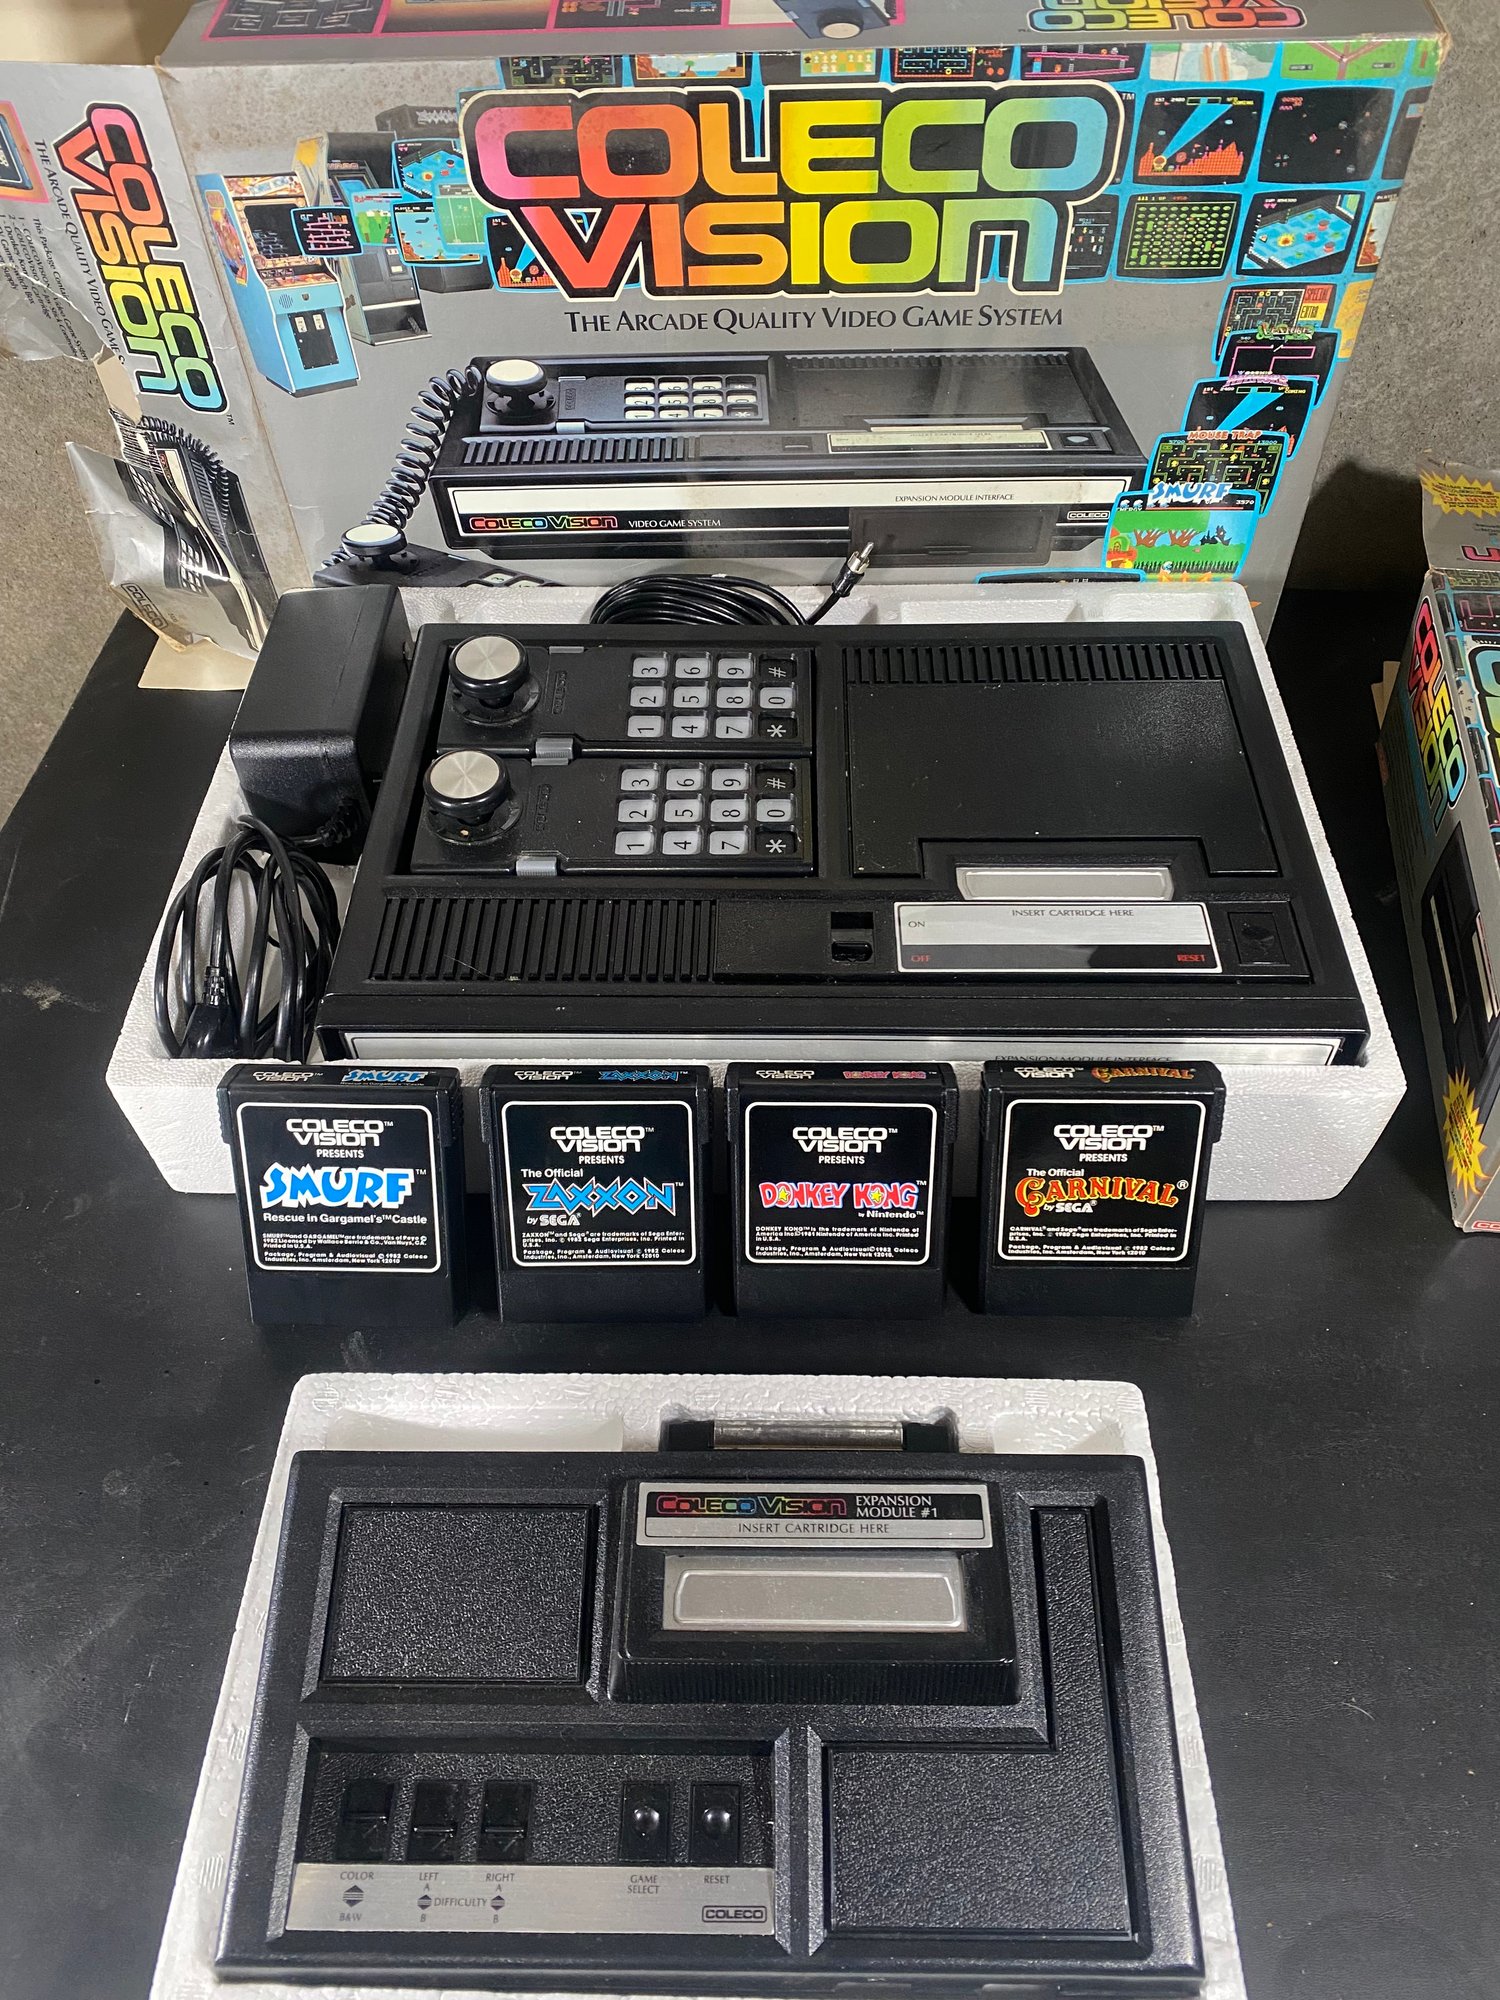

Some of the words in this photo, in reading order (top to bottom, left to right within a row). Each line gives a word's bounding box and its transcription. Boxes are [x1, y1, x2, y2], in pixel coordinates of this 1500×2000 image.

[1032, 7, 1301, 30] COLECO
[472, 95, 1110, 201] COLECO
[34, 138, 51, 167] THE
[47, 168, 71, 221] ARCADE
[64, 221, 91, 282] QUALITY
[86, 280, 106, 317] VIDEO
[518, 198, 1060, 290] VISION
[57, 126, 178, 392] VISION
[89, 106, 224, 410] COLECO
[564, 311, 611, 333] THE
[616, 311, 709, 332] ARCADE
[713, 308, 816, 335] QUALITY
[821, 307, 896, 329] VIDEO
[903, 305, 973, 328] GAME
[977, 305, 1063, 327] SYSTEM
[1187, 431, 1228, 440] MOUSE
[1231, 430, 1261, 439] TRAP
[1149, 481, 1233, 504] SMURF
[895, 494, 938, 502] EXPANSION
[628, 520, 657, 528] VIDEO
[659, 519, 686, 528] GAME
[687, 519, 721, 527] SYSTEM
[641, 667, 658, 675] 3
[639, 695, 656, 705] 2
[682, 695, 700, 704] 5
[726, 696, 744, 704] 8
[681, 724, 698, 734] 4
[726, 726, 743, 734] 7
[631, 778, 650, 787] 3
[629, 810, 647, 819] 2
[674, 809, 694, 818] 5
[722, 809, 741, 818] 8
[674, 840, 691, 850] 4
[721, 841, 740, 850] 7
[1012, 909, 1045, 917] INSERT
[1048, 909, 1105, 917] CARTRIDGE
[1177, 954, 1205, 962] RESET
[341, 1069, 429, 1083] SMURF
[1091, 1067, 1194, 1084] CARNIVAL
[286, 1118, 385, 1133] COLECO
[550, 1126, 645, 1140] COLECO
[792, 1126, 888, 1140] COLECO
[1053, 1124, 1153, 1138] COLECO
[293, 1132, 380, 1147] VISION
[1059, 1137, 1147, 1151] VISION
[557, 1139, 641, 1153] VISION
[798, 1139, 882, 1153] VISION
[316, 1149, 364, 1158] PRESENTS
[1079, 1153, 1128, 1163] PRESENTS
[579, 1155, 625, 1164] PRESENTS
[818, 1155, 865, 1164] PRESENTS
[521, 1169, 542, 1178] The
[544, 1168, 584, 1178] Official
[1026, 1168, 1047, 1177] The
[1048, 1168, 1085, 1177] Official
[259, 1161, 415, 1209] SMURF
[521, 1176, 676, 1218] ZAXXON
[759, 1182, 851, 1209] DONKEY
[853, 1182, 919, 1210] KONG
[1015, 1176, 1179, 1218] CARNIVAL
[1043, 1204, 1055, 1212] by
[1055, 1202, 1094, 1213] SEGA
[263, 1213, 305, 1222] Rescue
[307, 1214, 318, 1223] in
[392, 1215, 427, 1224] Castle
[866, 1210, 916, 1219] Nintendo
[526, 1216, 538, 1225] by
[539, 1214, 580, 1227] SEGA
[856, 1495, 932, 1507] EXPANSION
[856, 1507, 917, 1518] MODULE
[921, 1507, 938, 1518] #1
[738, 1522, 779, 1533] INSERT
[786, 1523, 855, 1534] CARTRIDGE
[859, 1524, 889, 1534] HERE
[340, 1871, 374, 1880] COLOR
[419, 1872, 439, 1881] LEFT
[486, 1873, 515, 1882] RIGHT
[630, 1875, 658, 1883] GAME
[704, 1875, 730, 1884] RESET
[424, 1884, 430, 1892] A
[496, 1884, 503, 1892] A
[627, 1886, 660, 1894] SELECT
[434, 1898, 488, 1907] DIFFICULTY
[339, 1913, 362, 1921] B&W
[493, 1915, 499, 1923] B
[705, 1909, 764, 1919] COLECO
